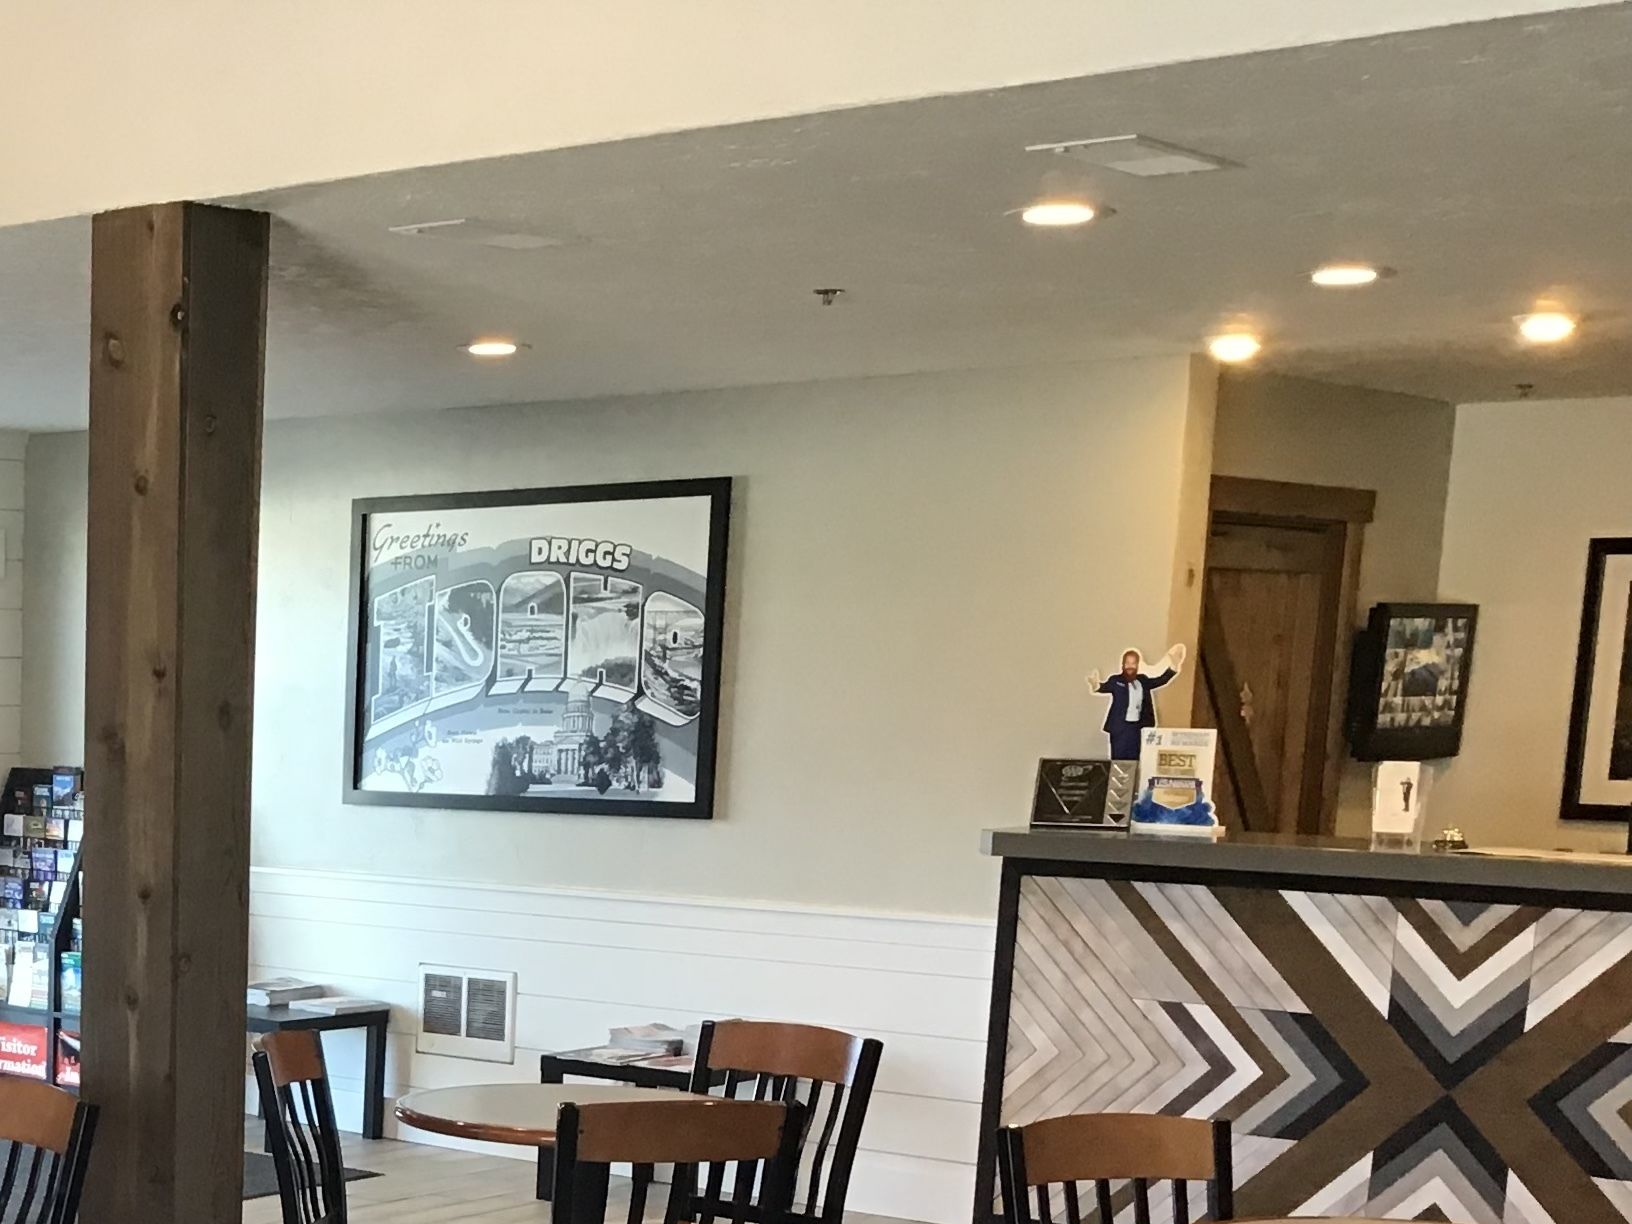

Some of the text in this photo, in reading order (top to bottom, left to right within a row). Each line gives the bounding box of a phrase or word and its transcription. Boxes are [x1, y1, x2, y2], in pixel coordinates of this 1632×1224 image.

[372, 522, 469, 563] Greetings
[529, 537, 633, 572] DRIGGS
[390, 554, 439, 571] FROM
[1158, 753, 1196, 767] BEST
